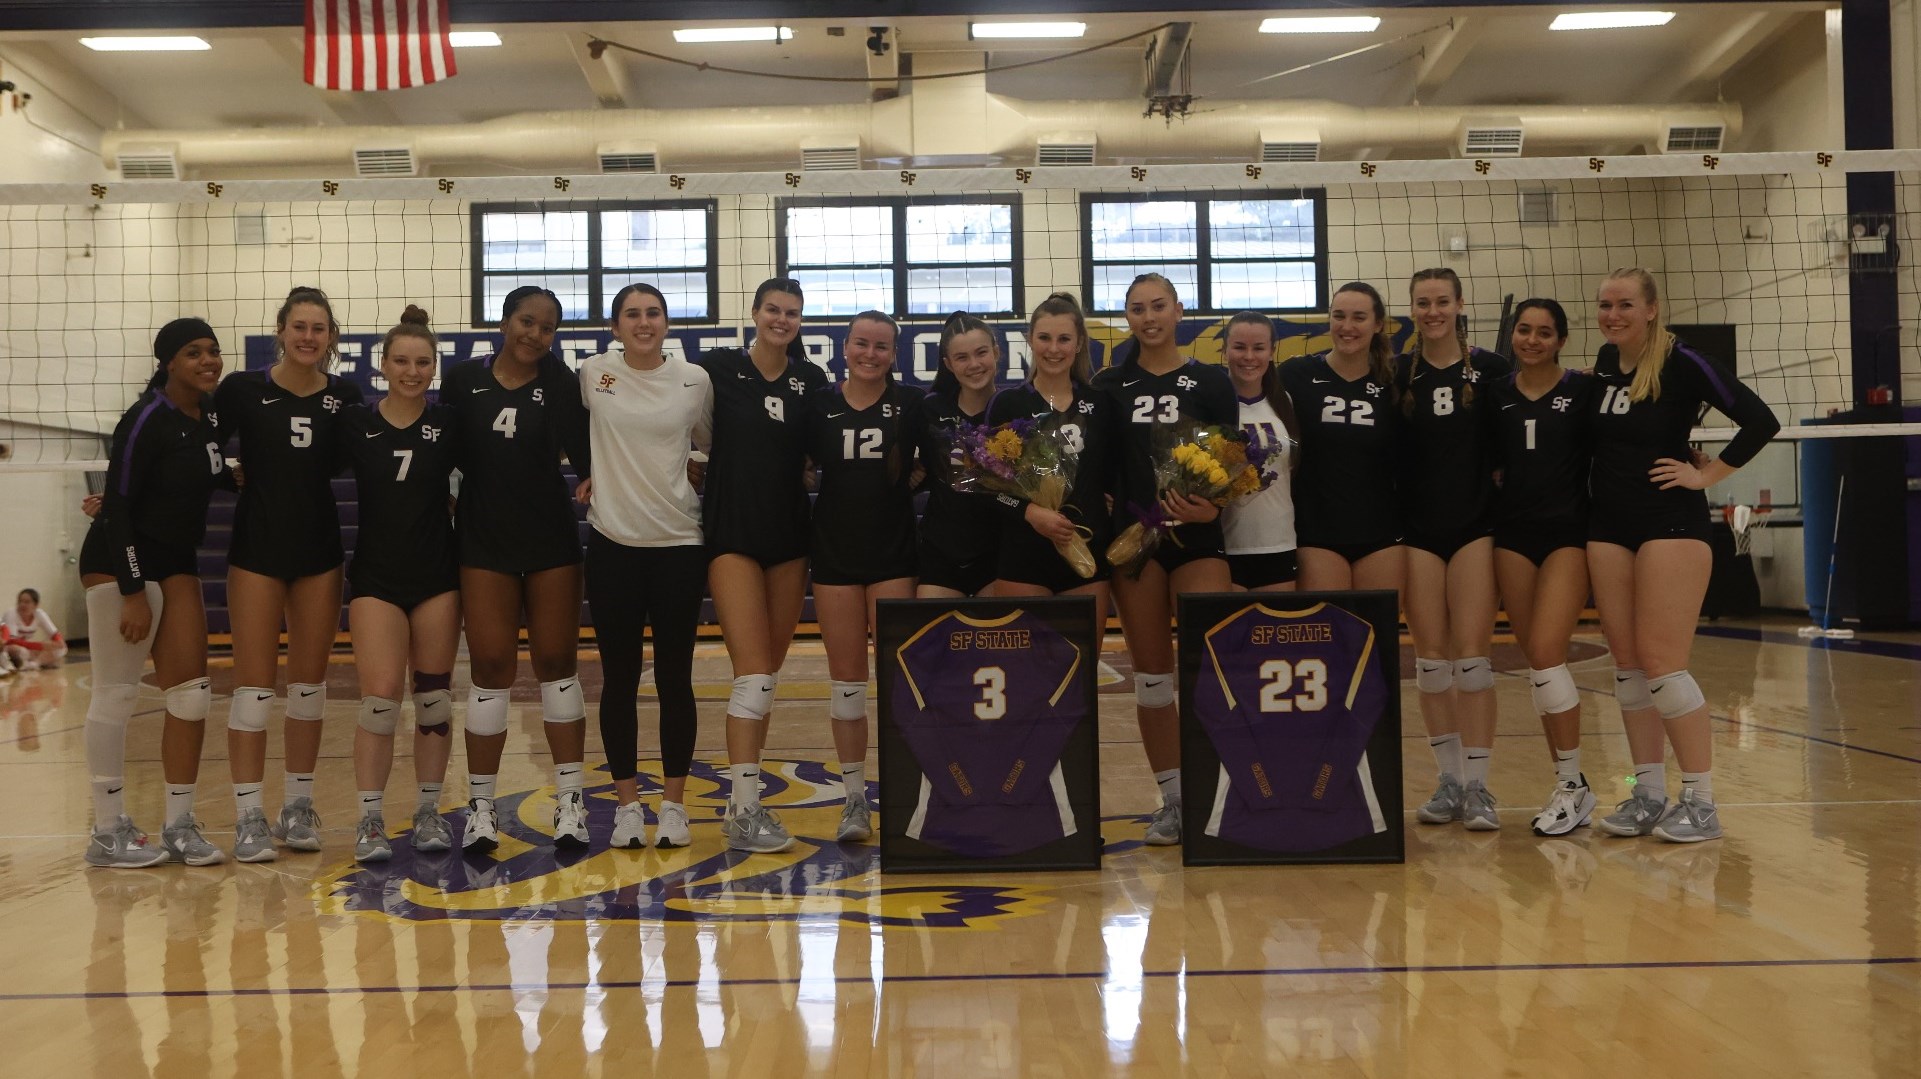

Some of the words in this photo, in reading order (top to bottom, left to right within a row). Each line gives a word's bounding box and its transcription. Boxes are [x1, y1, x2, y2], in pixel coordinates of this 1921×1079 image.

[1474, 159, 1492, 176] SF
[1588, 157, 1605, 173] SF
[1702, 154, 1720, 171] SF
[1816, 151, 1833, 168] SF
[900, 170, 917, 186] SF
[1015, 168, 1033, 184] SF
[1130, 166, 1147, 182] SF
[1245, 164, 1262, 180] SF
[1360, 161, 1377, 178] SF
[322, 180, 339, 196] SF
[438, 178, 455, 195] SF
[554, 176, 571, 192] SF
[669, 174, 686, 191] SF
[785, 172, 802, 188] SF
[90, 183, 108, 200] SF
[206, 181, 224, 198] SF
[600, 373, 616, 388] SF
[789, 377, 805, 395] SF
[1176, 374, 1198, 392] SF
[1366, 383, 1383, 397] SF
[323, 395, 342, 413] SF
[765, 396, 784, 422] 9
[1078, 400, 1094, 414] SF
[1132, 395, 1179, 423] 23
[1433, 387, 1454, 416] 8
[1552, 397, 1572, 412] SF
[1321, 395, 1376, 426] 22
[493, 408, 517, 438] 4
[291, 417, 312, 447] 5
[422, 425, 441, 442] SF
[1061, 423, 1085, 453] 3
[1525, 419, 1536, 449] 1
[843, 428, 882, 459] 12
[206, 442, 222, 474] 6
[394, 450, 412, 481] 7
[126, 546, 140, 578] GATORS
[951, 631, 973, 650] SF
[976, 630, 1030, 649] STATE
[1252, 625, 1273, 644] SF
[1277, 623, 1332, 642] STATE
[973, 666, 1007, 720] 3
[1259, 658, 1328, 713] 23
